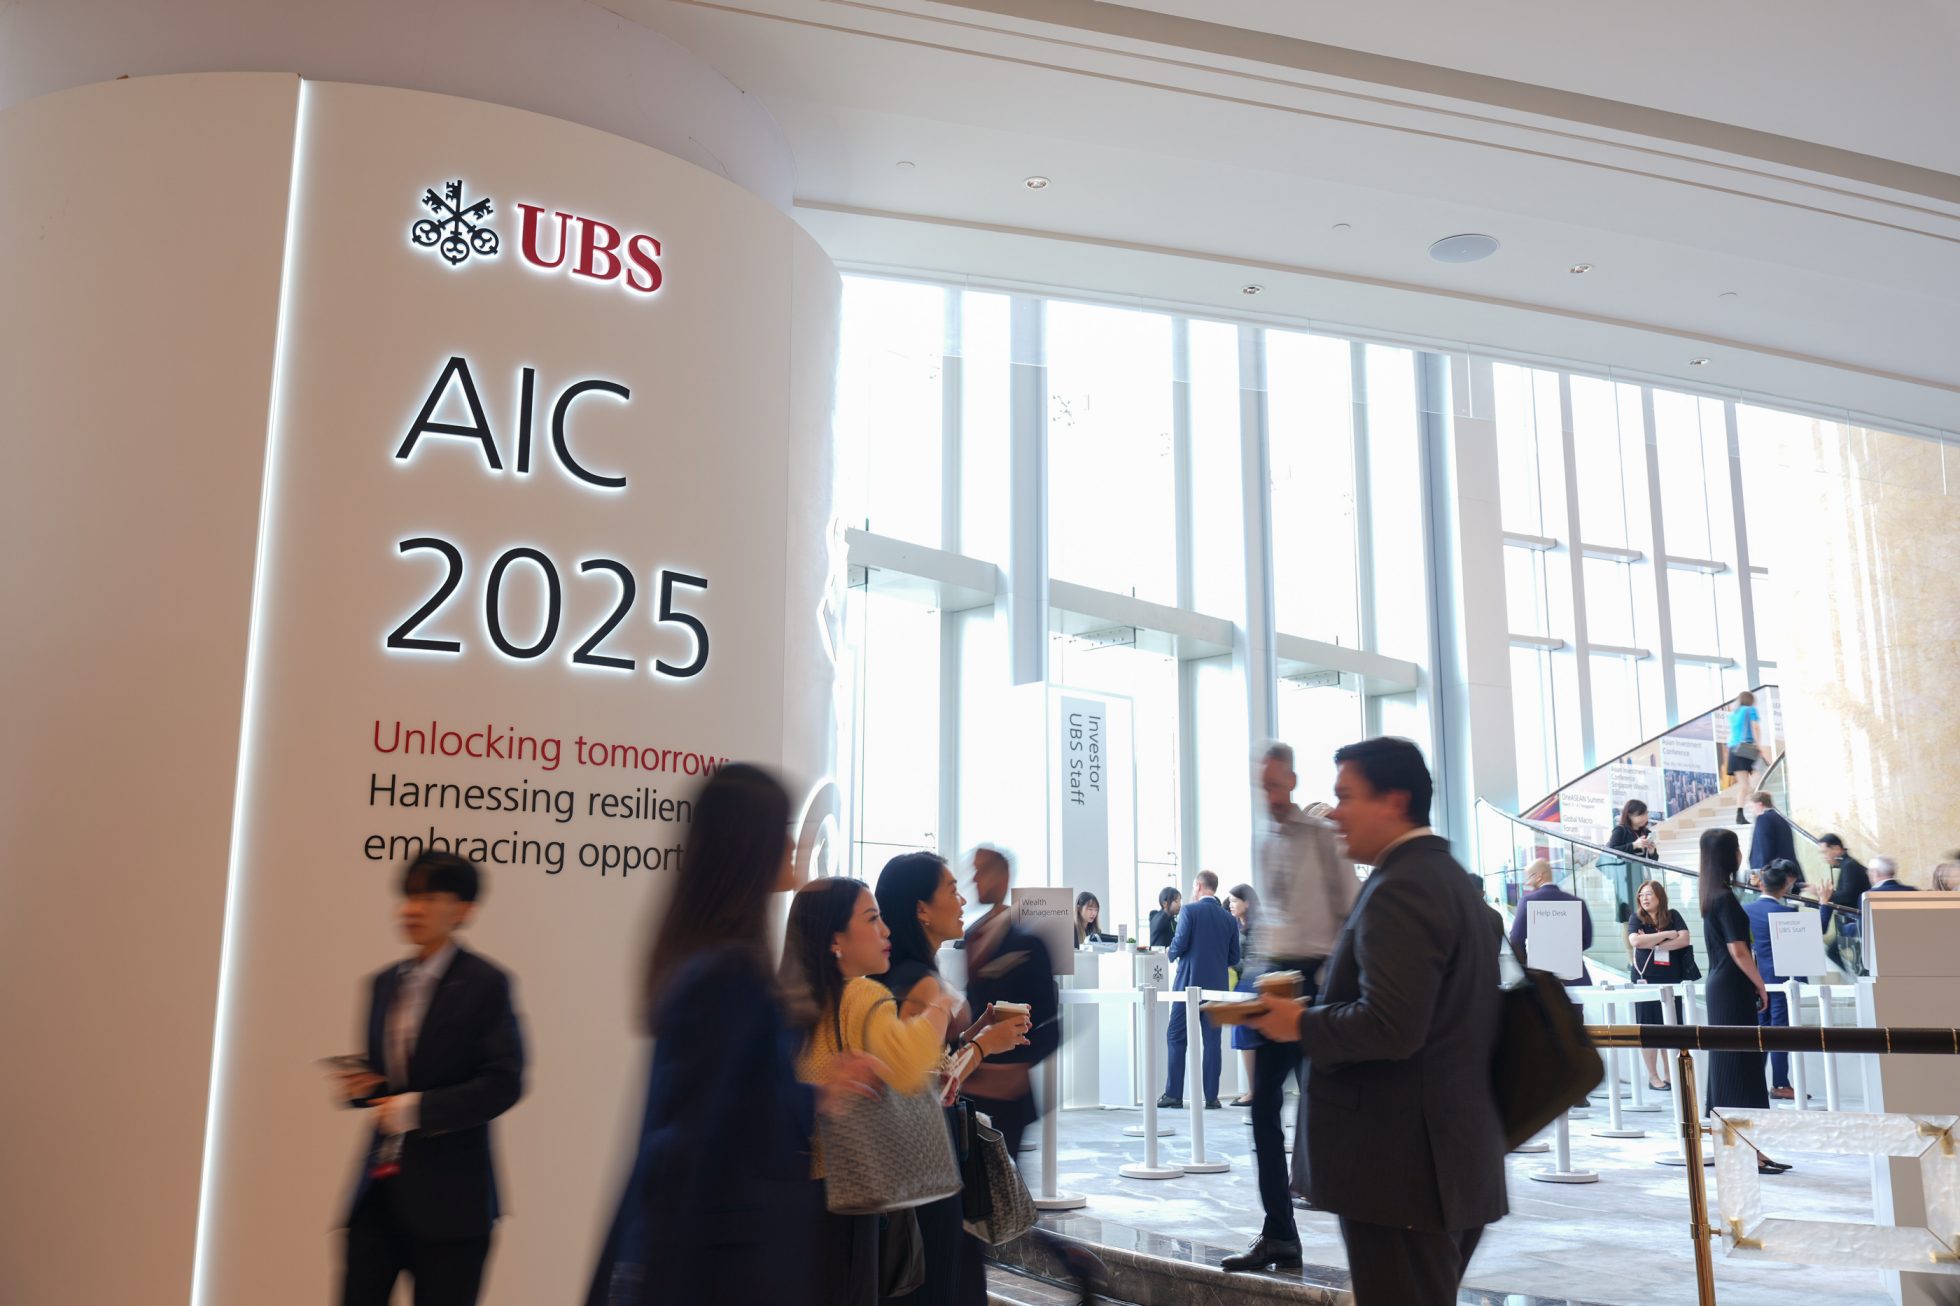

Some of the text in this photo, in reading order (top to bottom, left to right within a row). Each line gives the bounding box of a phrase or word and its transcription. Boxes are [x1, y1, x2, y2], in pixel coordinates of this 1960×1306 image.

[517, 203, 663, 293] UBS
[395, 356, 631, 488] AIC
[387, 537, 709, 678] 2025
[373, 720, 562, 771] Unlocking
[1069, 713, 1085, 806] UBS Staff
[1088, 715, 1101, 792] Investor
[369, 773, 694, 824] Harnessing resilien
[364, 826, 685, 877] embracing opport
[1021, 897, 1047, 906] Wealth
[1021, 908, 1068, 918] Management
[1536, 909, 1567, 918] Help Desk
